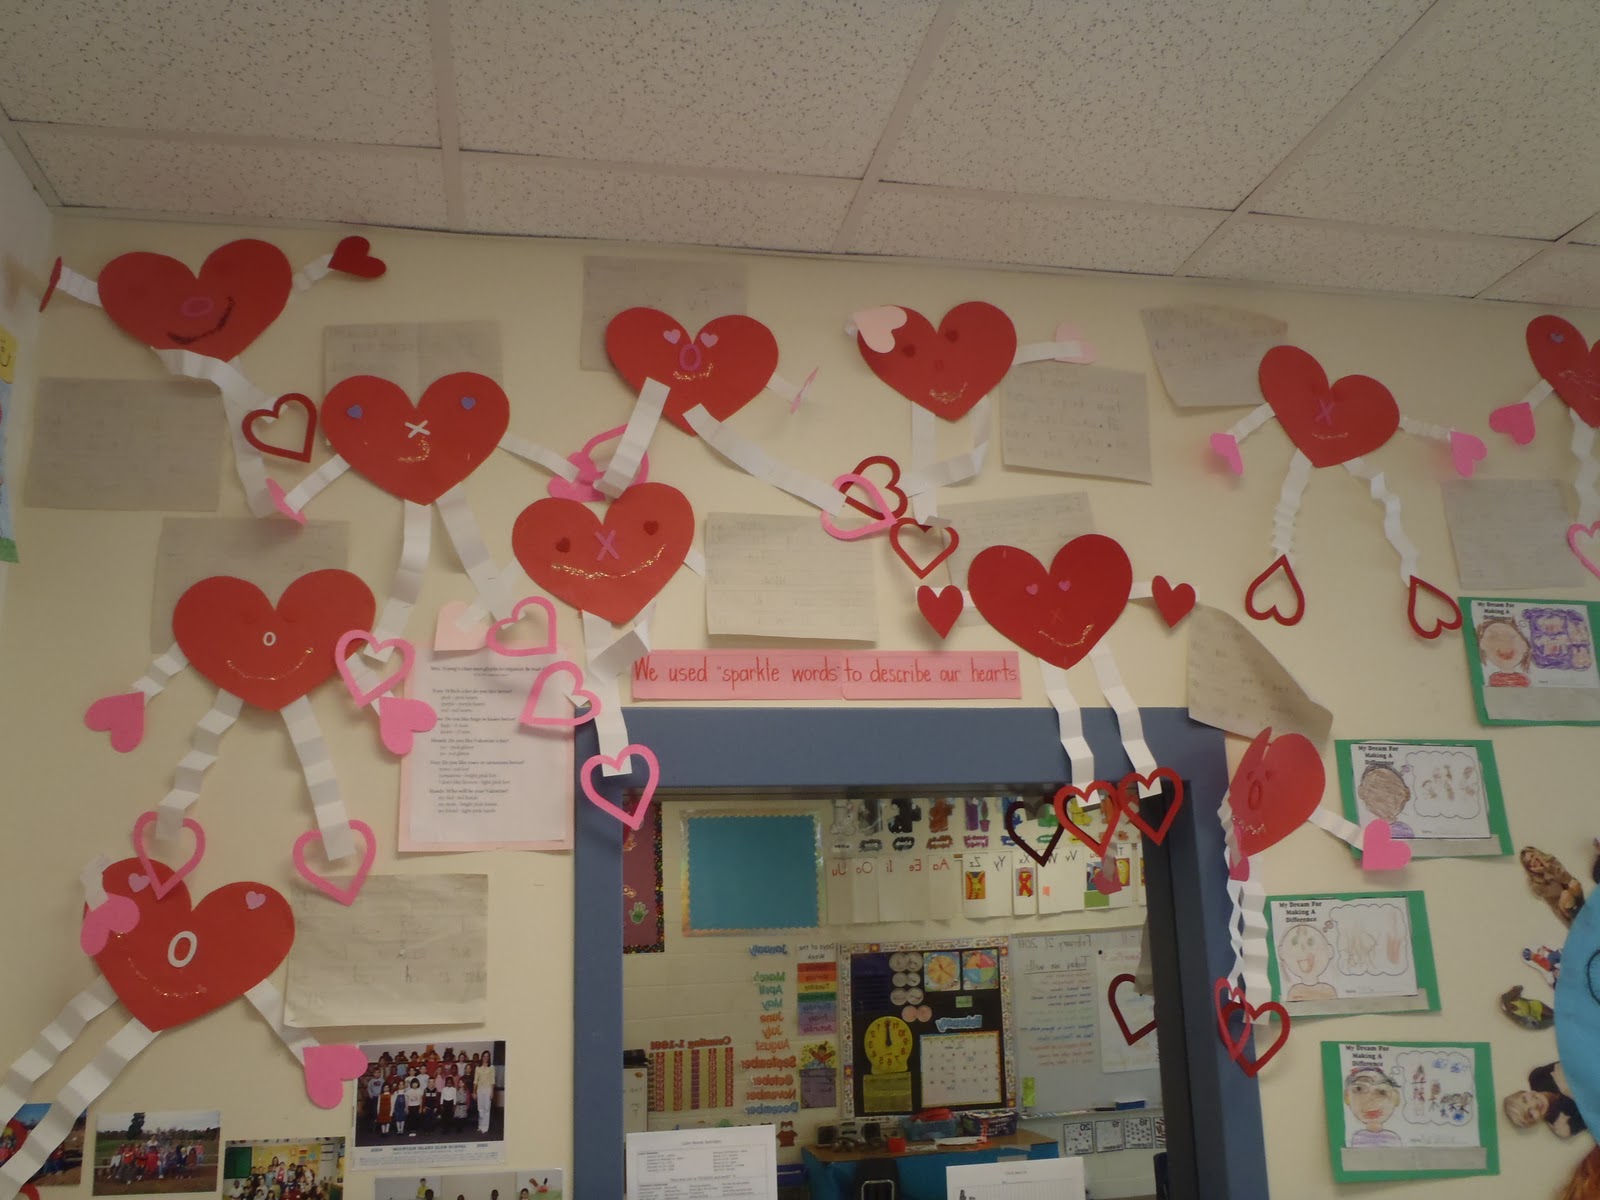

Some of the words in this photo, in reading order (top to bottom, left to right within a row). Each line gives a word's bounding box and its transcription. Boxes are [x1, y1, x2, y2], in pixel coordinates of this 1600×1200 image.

[634, 655, 658, 681] We
[669, 656, 707, 682] used
[844, 657, 862, 682] to
[870, 657, 931, 683] describe
[940, 668, 960, 682] our
